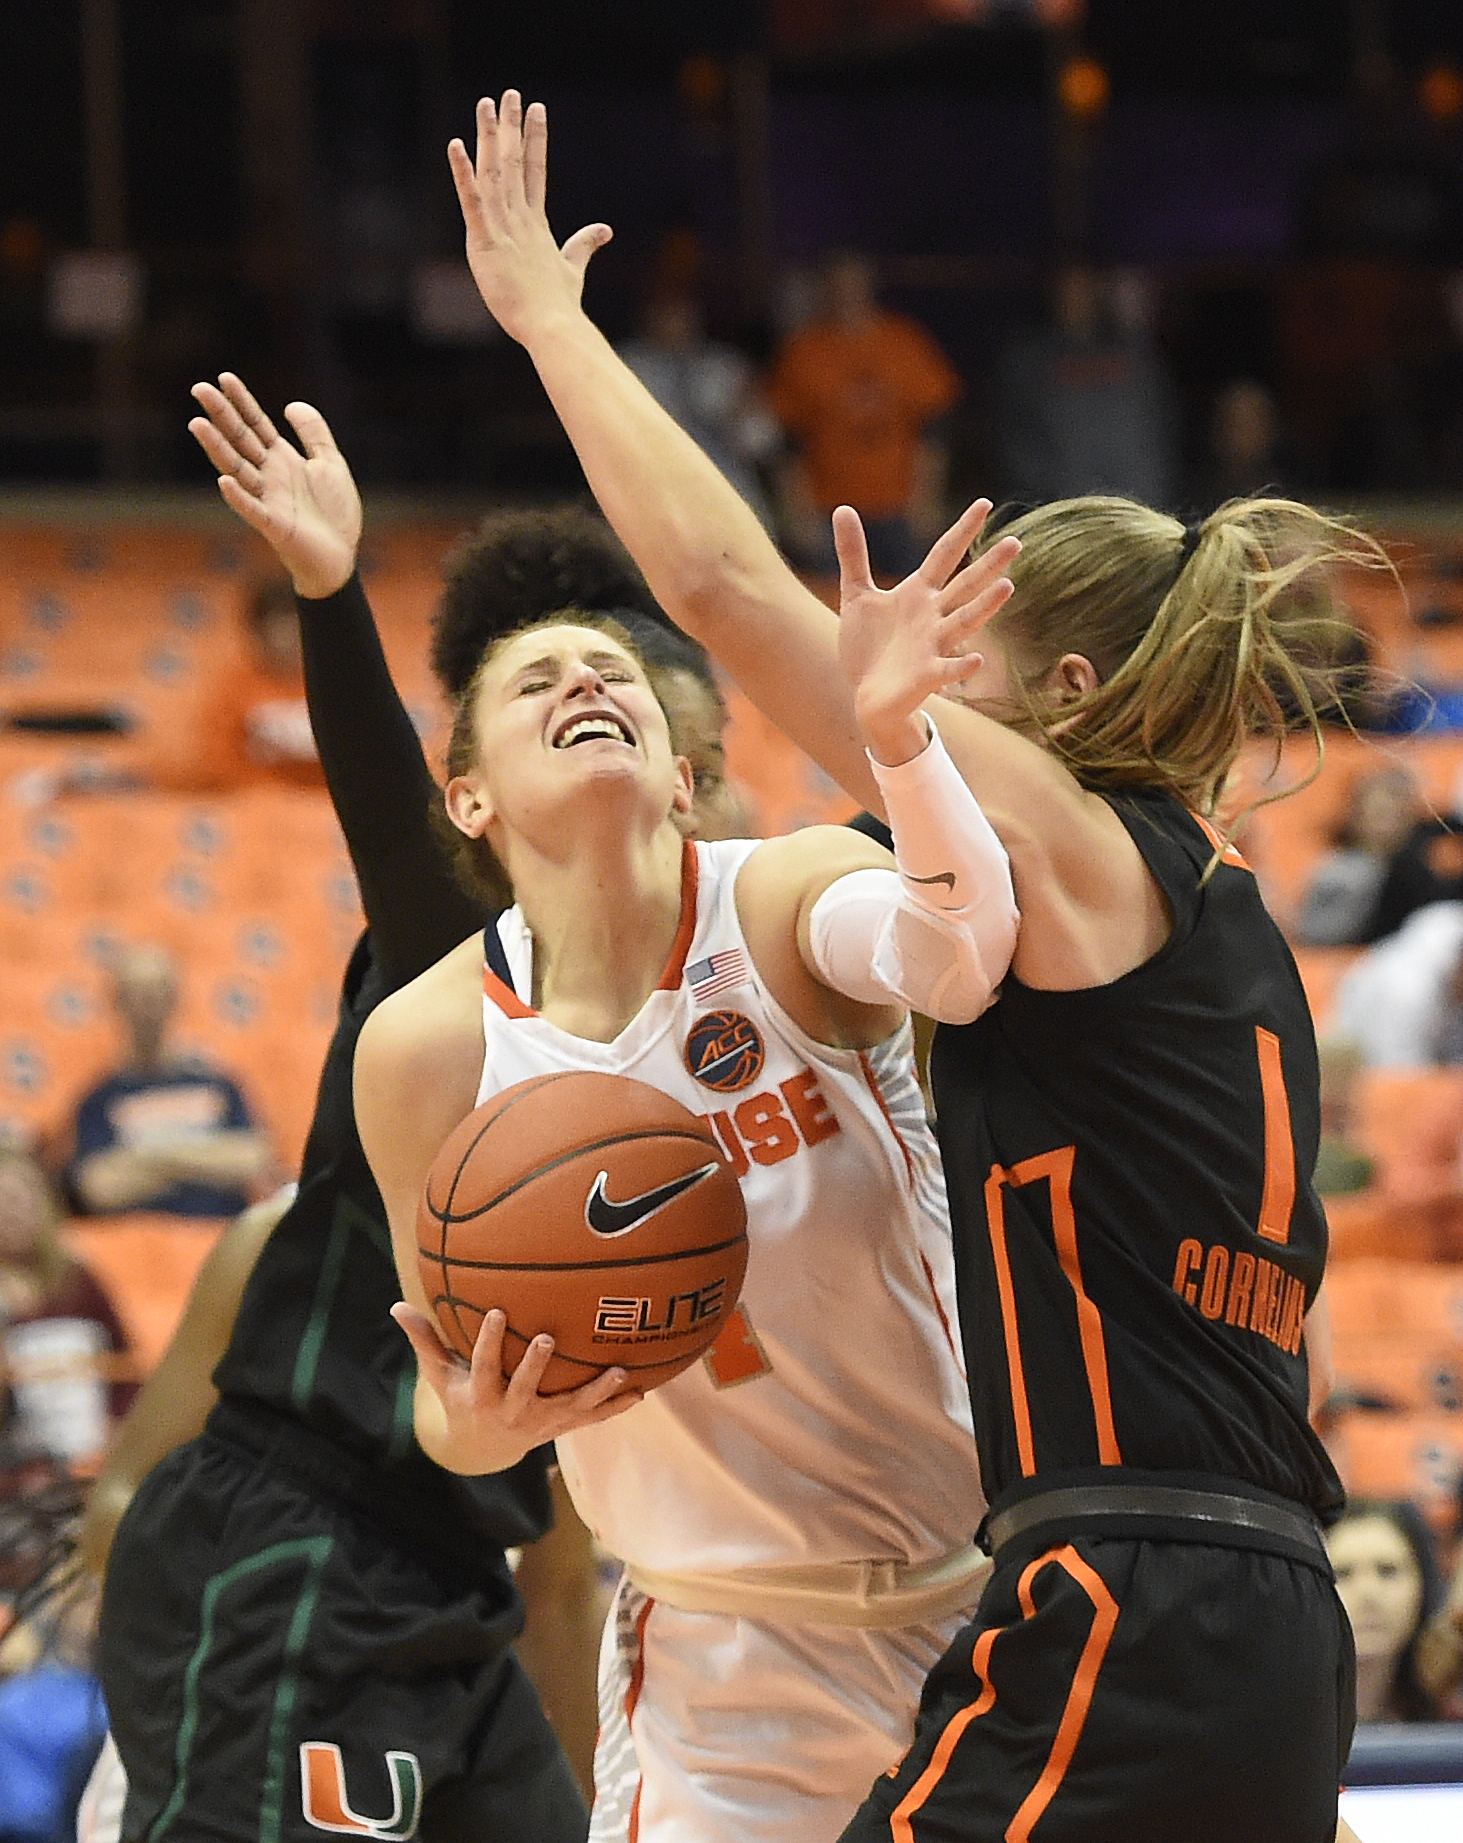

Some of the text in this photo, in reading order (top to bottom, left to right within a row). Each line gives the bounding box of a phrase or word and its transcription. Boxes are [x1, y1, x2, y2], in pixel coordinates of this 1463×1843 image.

[699, 1018, 754, 1067] ACC
[1256, 1026, 1297, 1245] 1
[594, 1277, 726, 1334] ELITE
[300, 1741, 422, 1841] U
